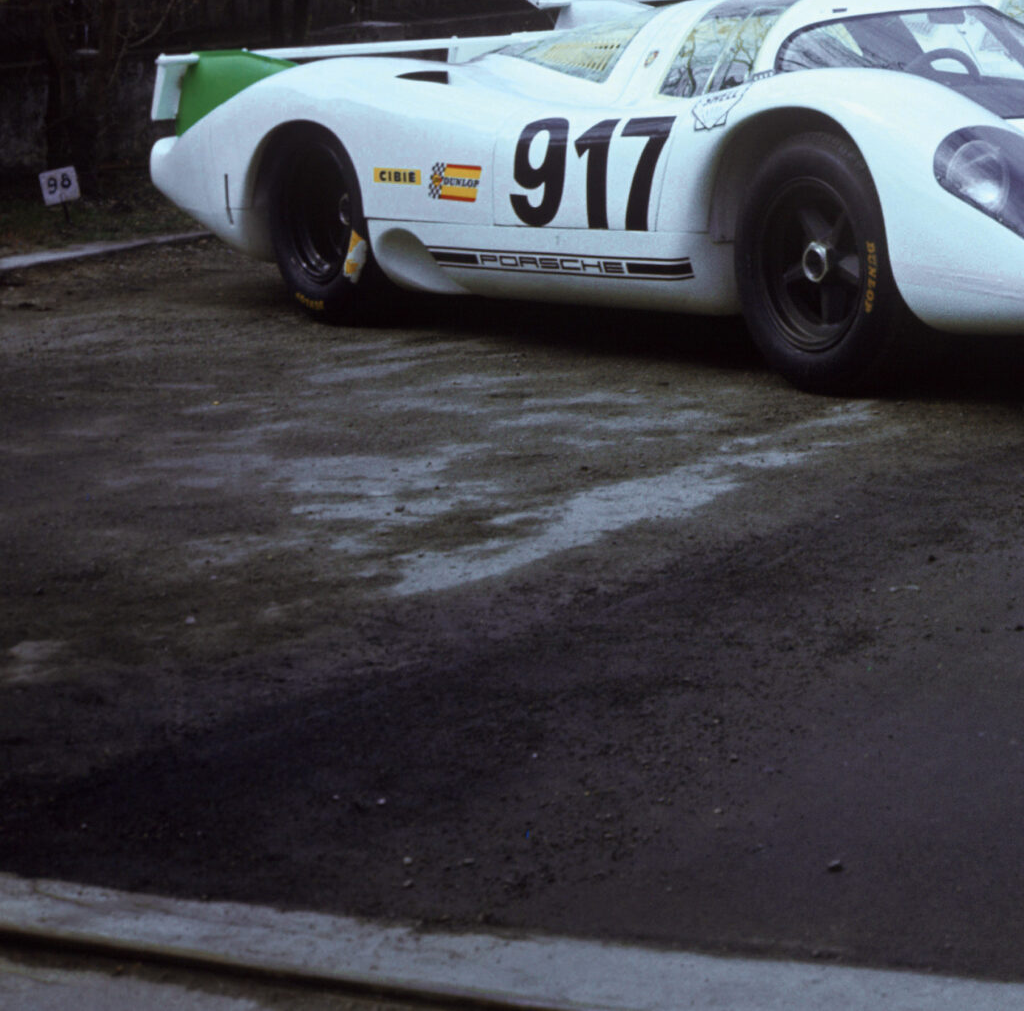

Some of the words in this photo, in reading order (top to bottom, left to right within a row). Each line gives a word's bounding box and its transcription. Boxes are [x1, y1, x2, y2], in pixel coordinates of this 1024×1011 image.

[379, 170, 416, 183] CIBIE
[443, 177, 480, 188] DUNLOP
[509, 116, 677, 231] 917
[480, 254, 625, 274] PORSCHE
[865, 240, 876, 313] DUNLOP
